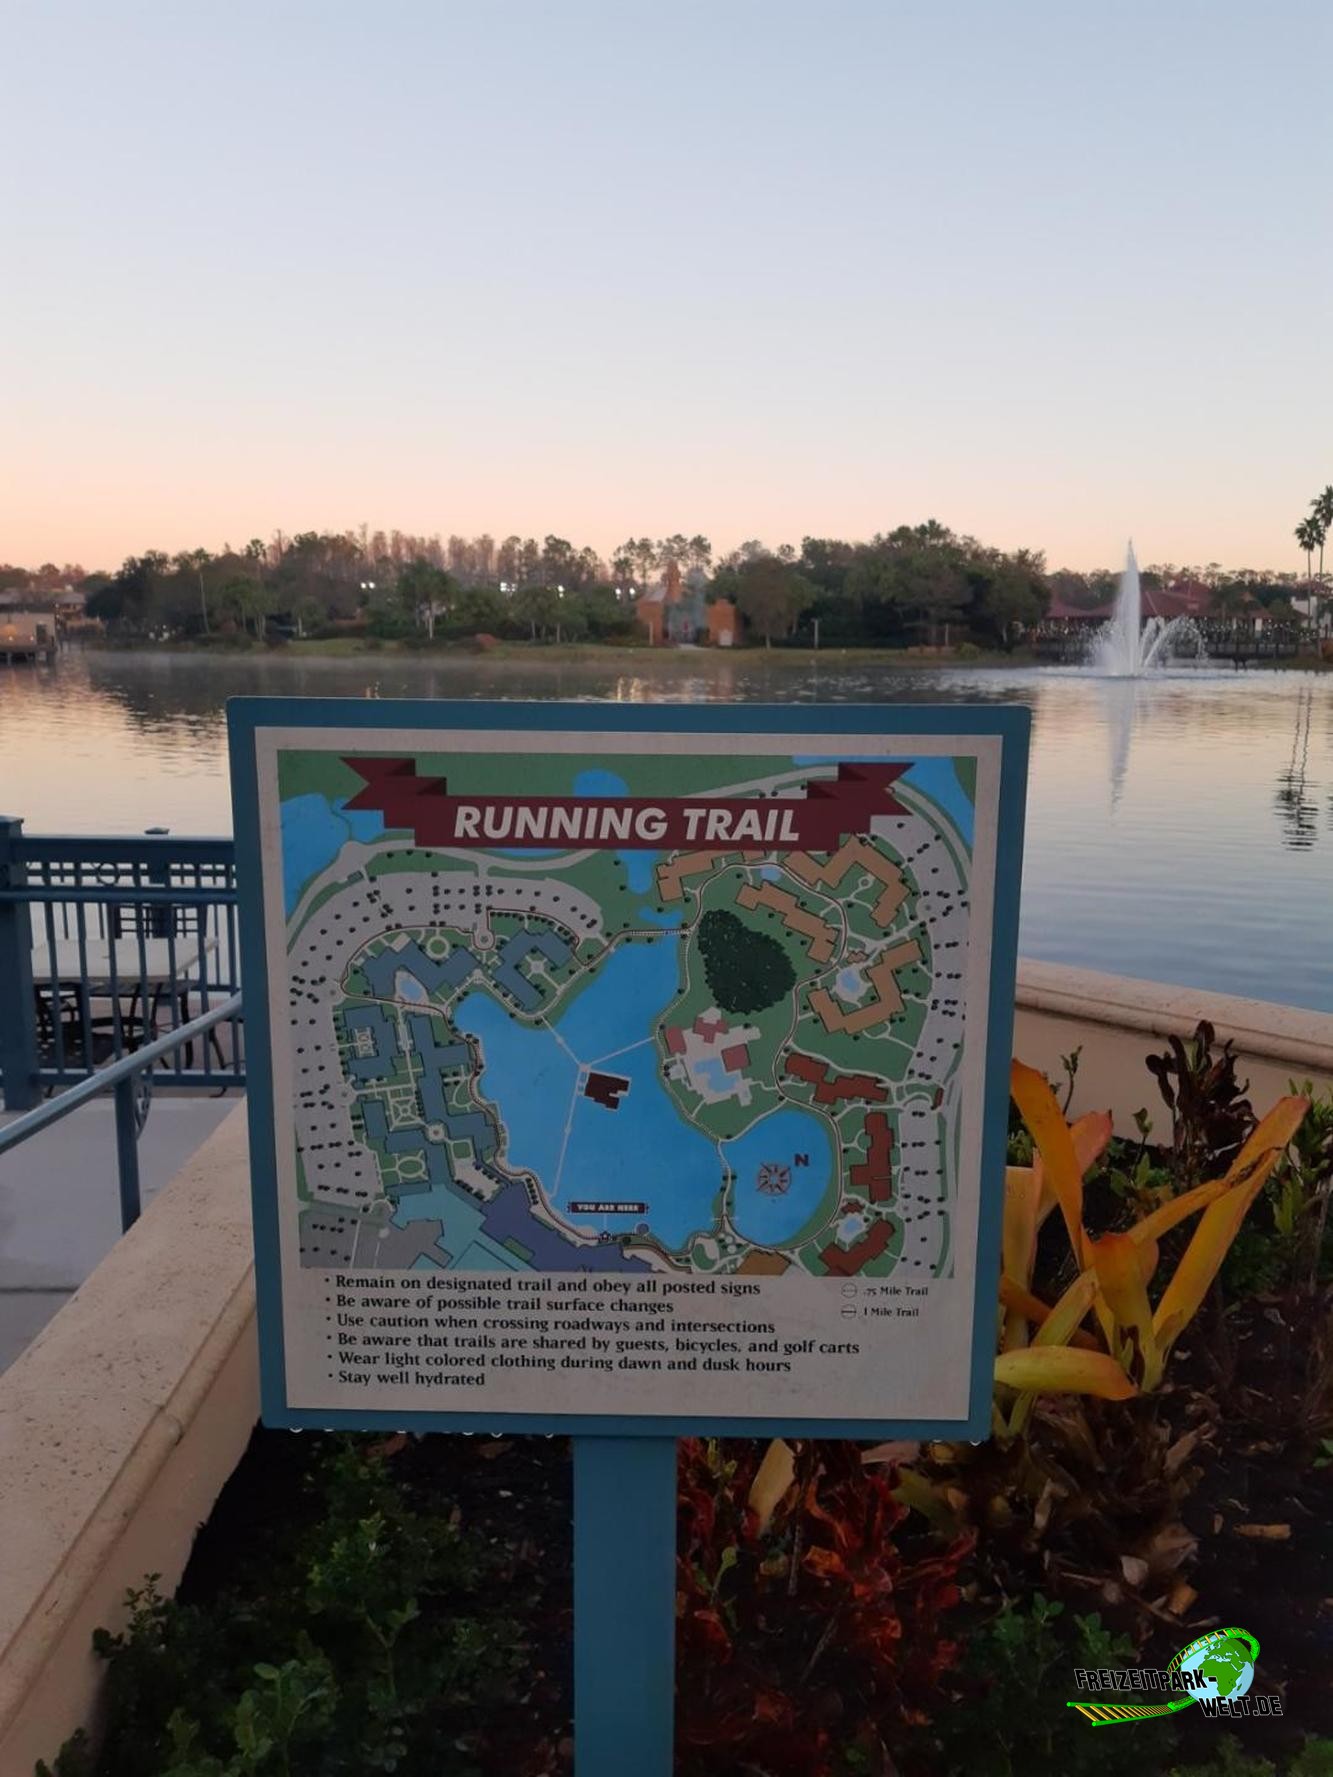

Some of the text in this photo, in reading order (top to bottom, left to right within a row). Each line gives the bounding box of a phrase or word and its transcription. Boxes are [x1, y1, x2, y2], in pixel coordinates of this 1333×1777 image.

[453, 806, 801, 842] RUNNING TRAIL
[795, 1154, 809, 1166] N
[335, 1275, 761, 1297] Remain on designated trail and obey all posted signs
[880, 1286, 902, 1295] Mile
[905, 1286, 928, 1296] Trail
[337, 1294, 674, 1315] Be aware of possible trail surface changes
[871, 1307, 894, 1317] Mile
[897, 1308, 919, 1317] Trail
[337, 1314, 775, 1334] Use caution when crossing roadways and intersections
[338, 1333, 859, 1356] Be aware that trails are shared by guests, bicycles, and golf carts
[338, 1352, 791, 1372] Wear light colored clothing during dawn and dusk hours
[338, 1370, 485, 1387] Stay well hydrated
